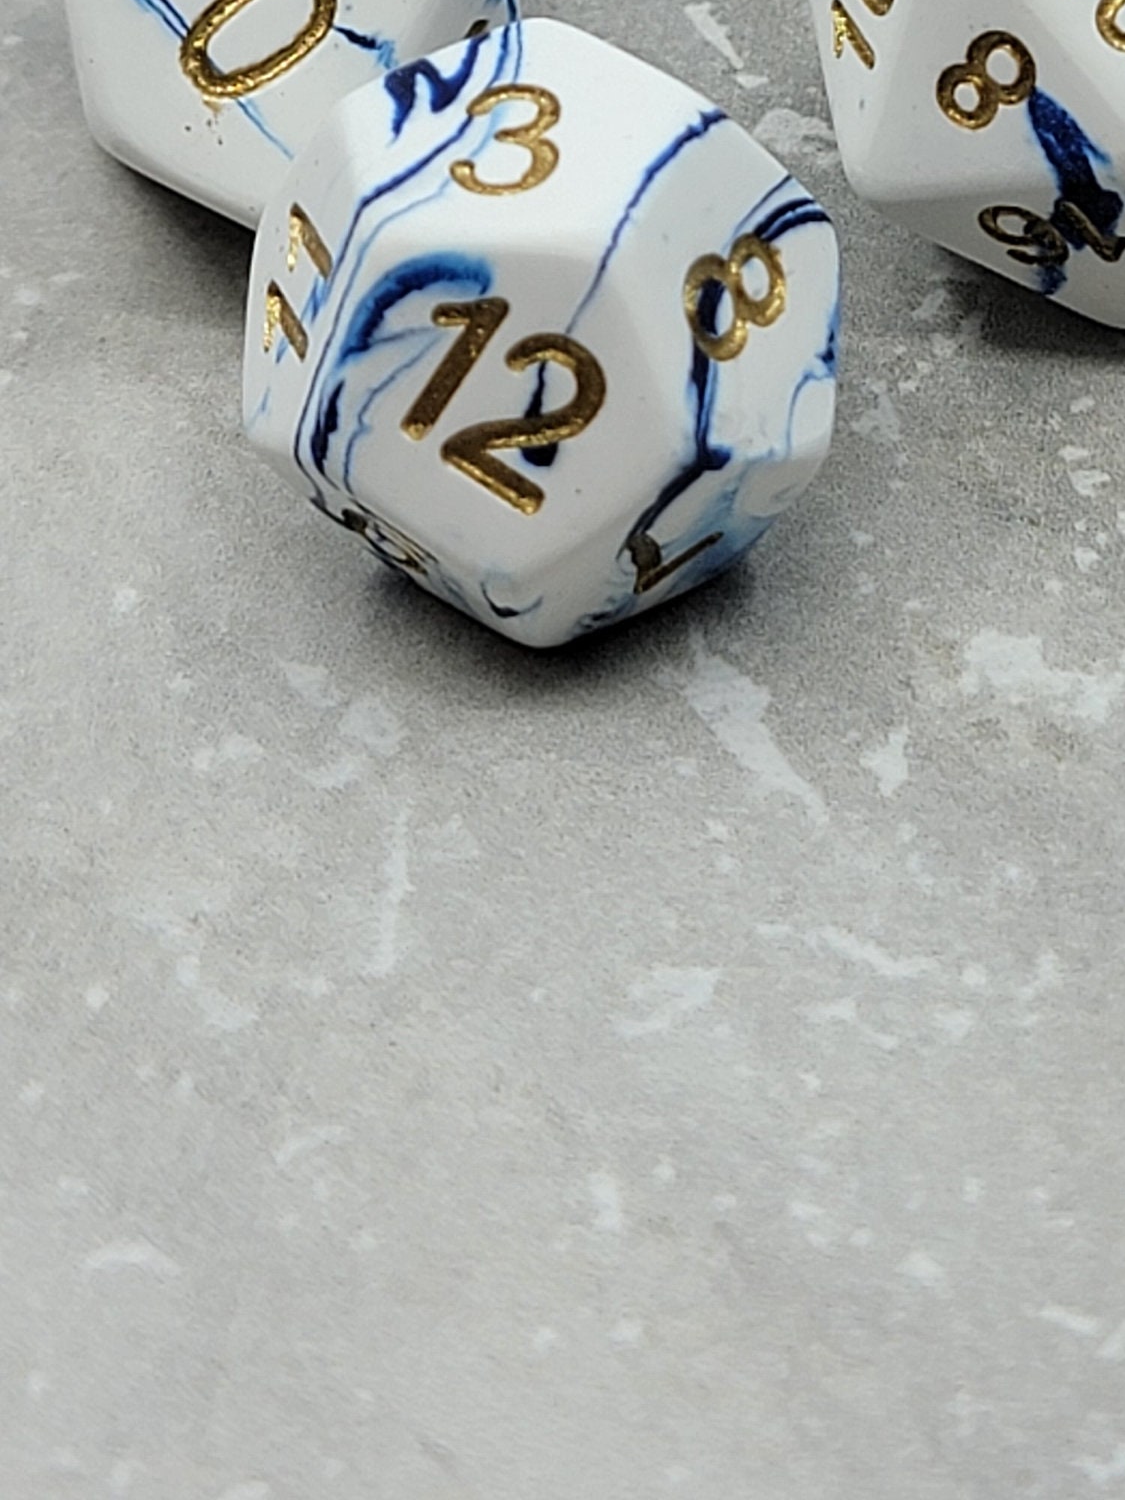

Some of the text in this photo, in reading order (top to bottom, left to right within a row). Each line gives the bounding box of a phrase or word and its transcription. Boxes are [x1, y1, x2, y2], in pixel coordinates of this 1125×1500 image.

[448, 84, 561, 196] 3
[935, 29, 1037, 130] 8
[263, 201, 334, 364] 11
[683, 232, 787, 362] 8
[399, 296, 607, 515] 12
